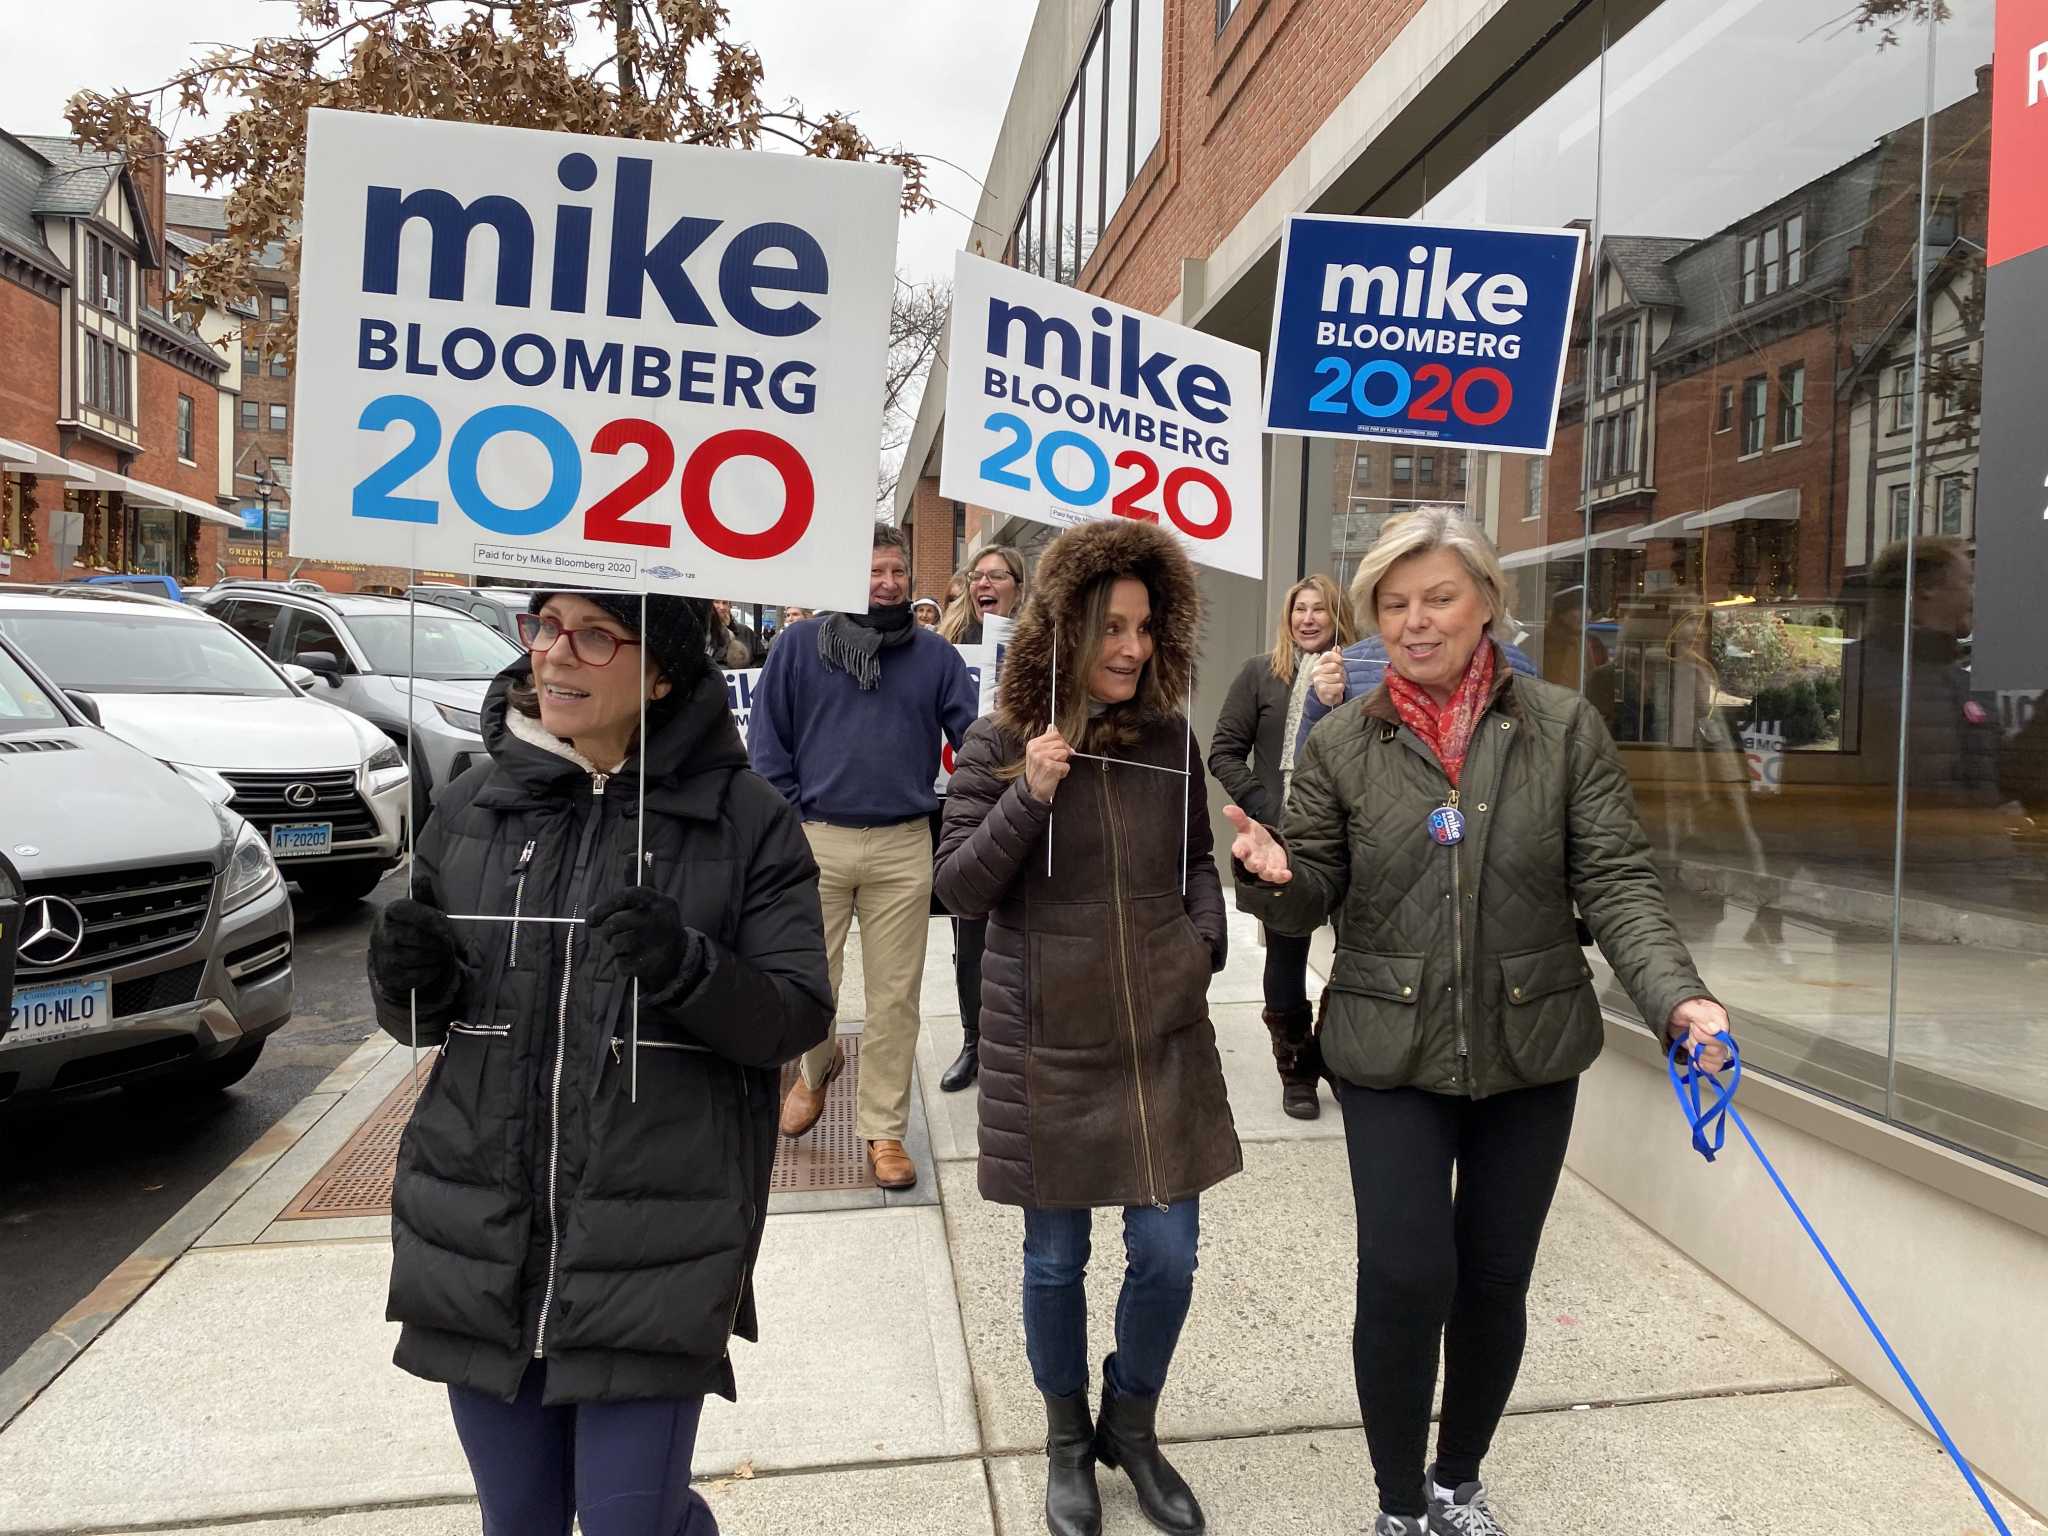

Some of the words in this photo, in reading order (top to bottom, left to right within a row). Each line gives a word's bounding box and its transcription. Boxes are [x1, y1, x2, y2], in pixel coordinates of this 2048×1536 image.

[361, 152, 829, 337] mike
[1321, 245, 1528, 326] mike
[358, 318, 817, 415] BLOOMBERG
[987, 297, 1232, 424] mike
[1316, 322, 1522, 360] BLOOMBERG
[983, 367, 1230, 466] BLOOMBERG
[1309, 356, 1513, 426] 2020
[352, 394, 815, 560] 2020
[979, 412, 1233, 540] 2020
[478, 549, 499, 559] Paid
[502, 553, 513, 561] for
[516, 553, 528, 564] by
[530, 554, 552, 564] Mike
[555, 556, 605, 572] Bloomberg
[607, 562, 631, 572] 2020
